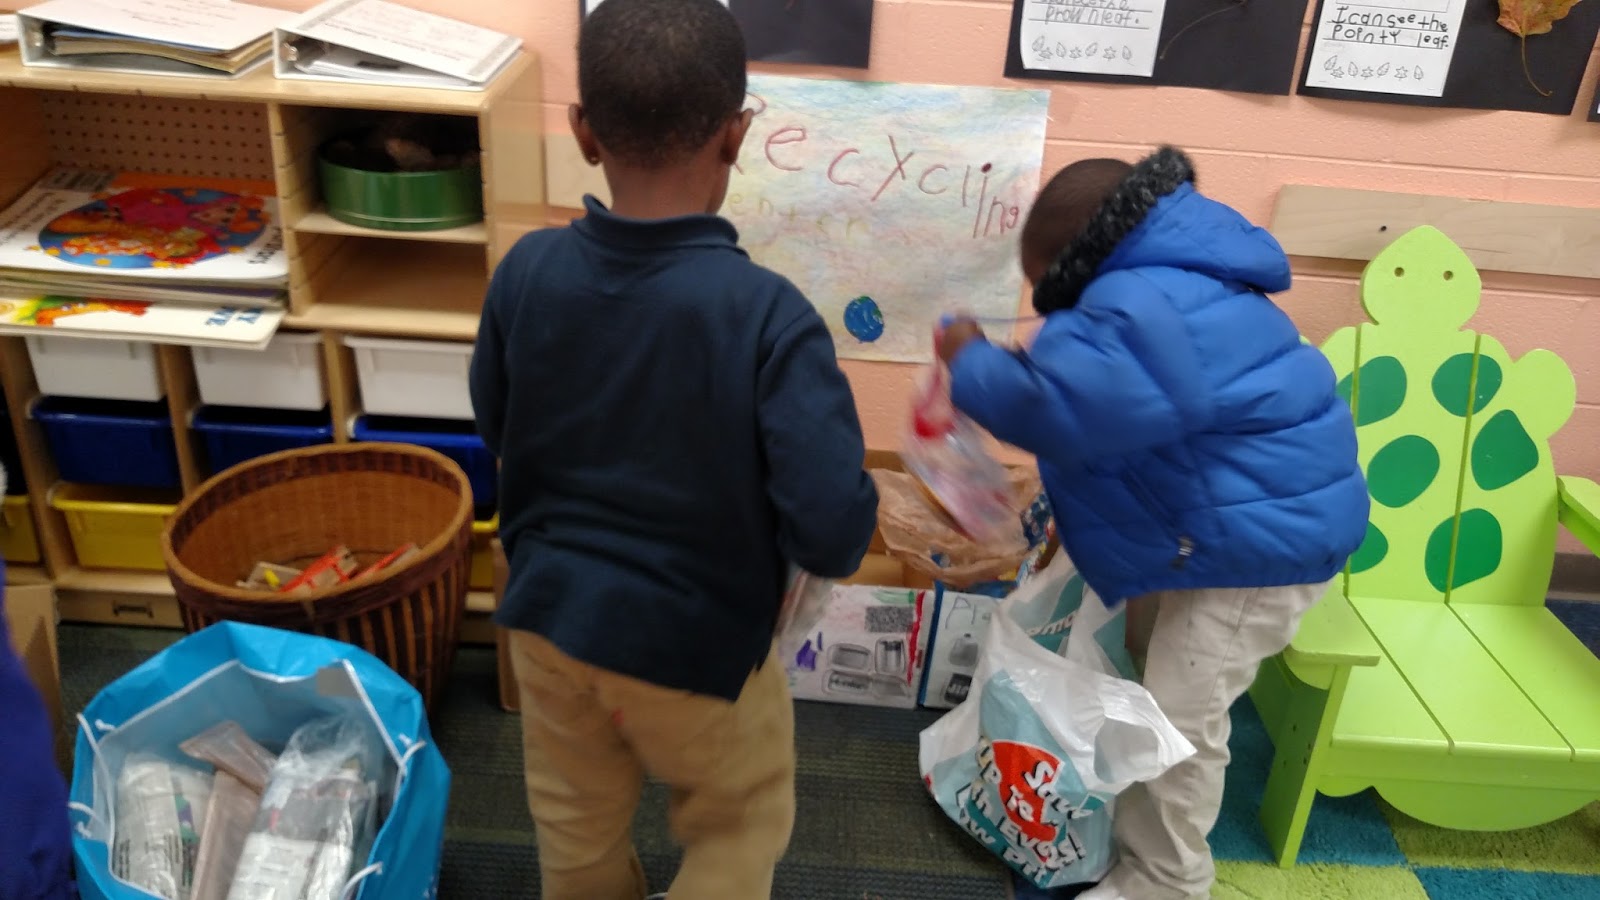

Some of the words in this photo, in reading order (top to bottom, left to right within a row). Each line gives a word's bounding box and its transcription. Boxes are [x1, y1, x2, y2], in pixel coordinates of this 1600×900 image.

[1331, 6, 1349, 24] I
[1348, 13, 1383, 27] can
[1386, 14, 1416, 28] see
[1418, 13, 1448, 32] the
[728, 193, 871, 238] enter
